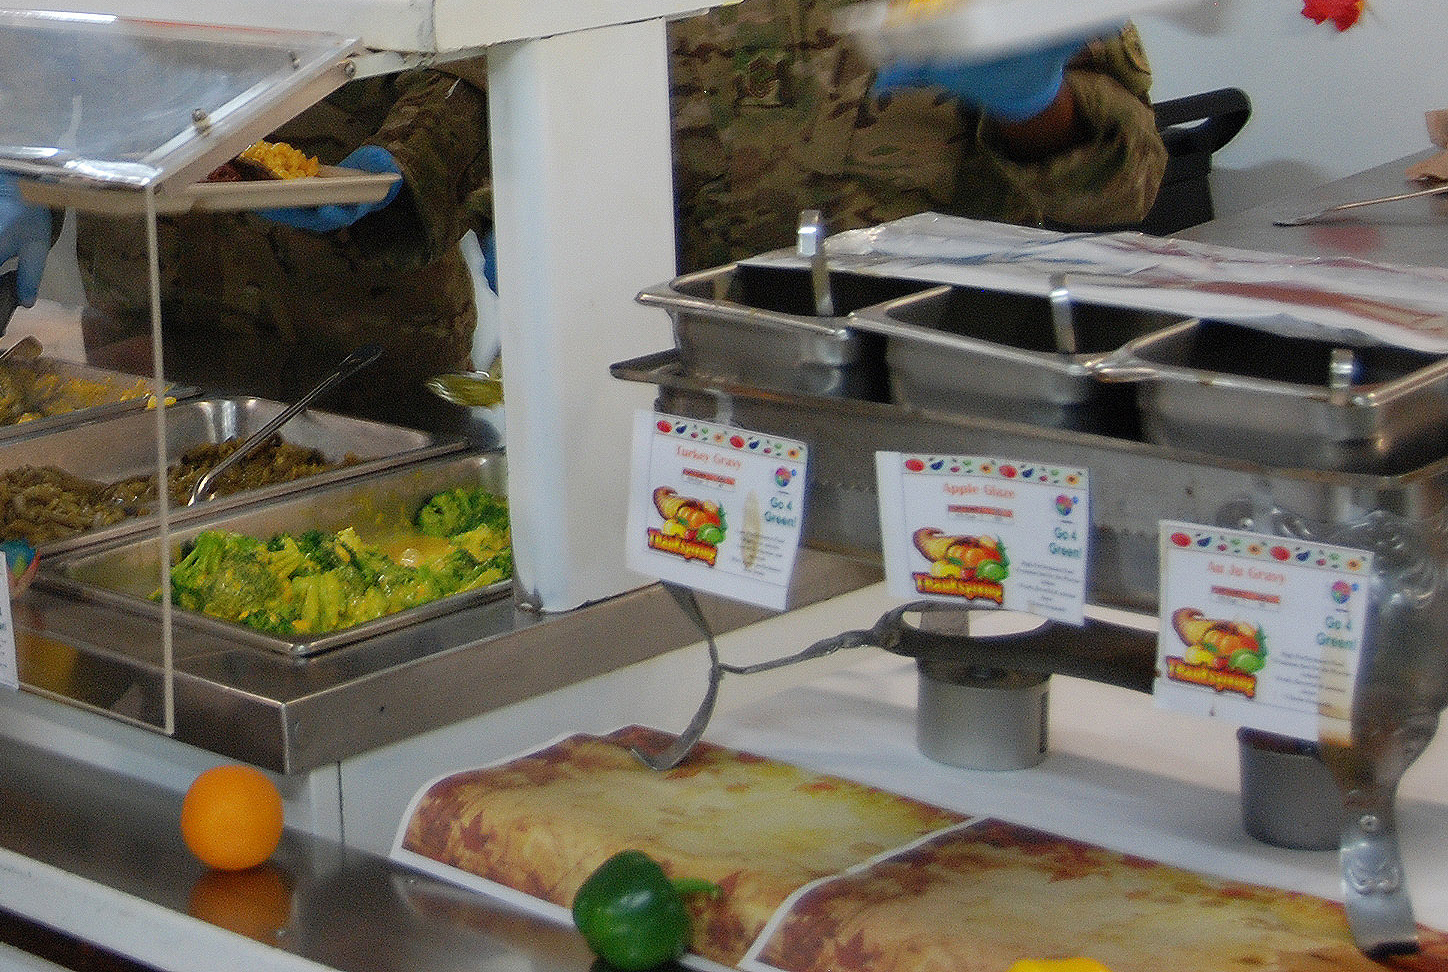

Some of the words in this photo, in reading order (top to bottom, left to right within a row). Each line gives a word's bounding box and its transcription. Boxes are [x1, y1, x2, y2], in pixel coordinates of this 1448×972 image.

[676, 445, 709, 463] Turkey
[713, 452, 742, 469] Gravy
[943, 482, 979, 496] Apple
[769, 496, 784, 509] Go
[786, 501, 793, 510] 4
[1054, 526, 1069, 540] Go
[1325, 615, 1342, 630] Go
